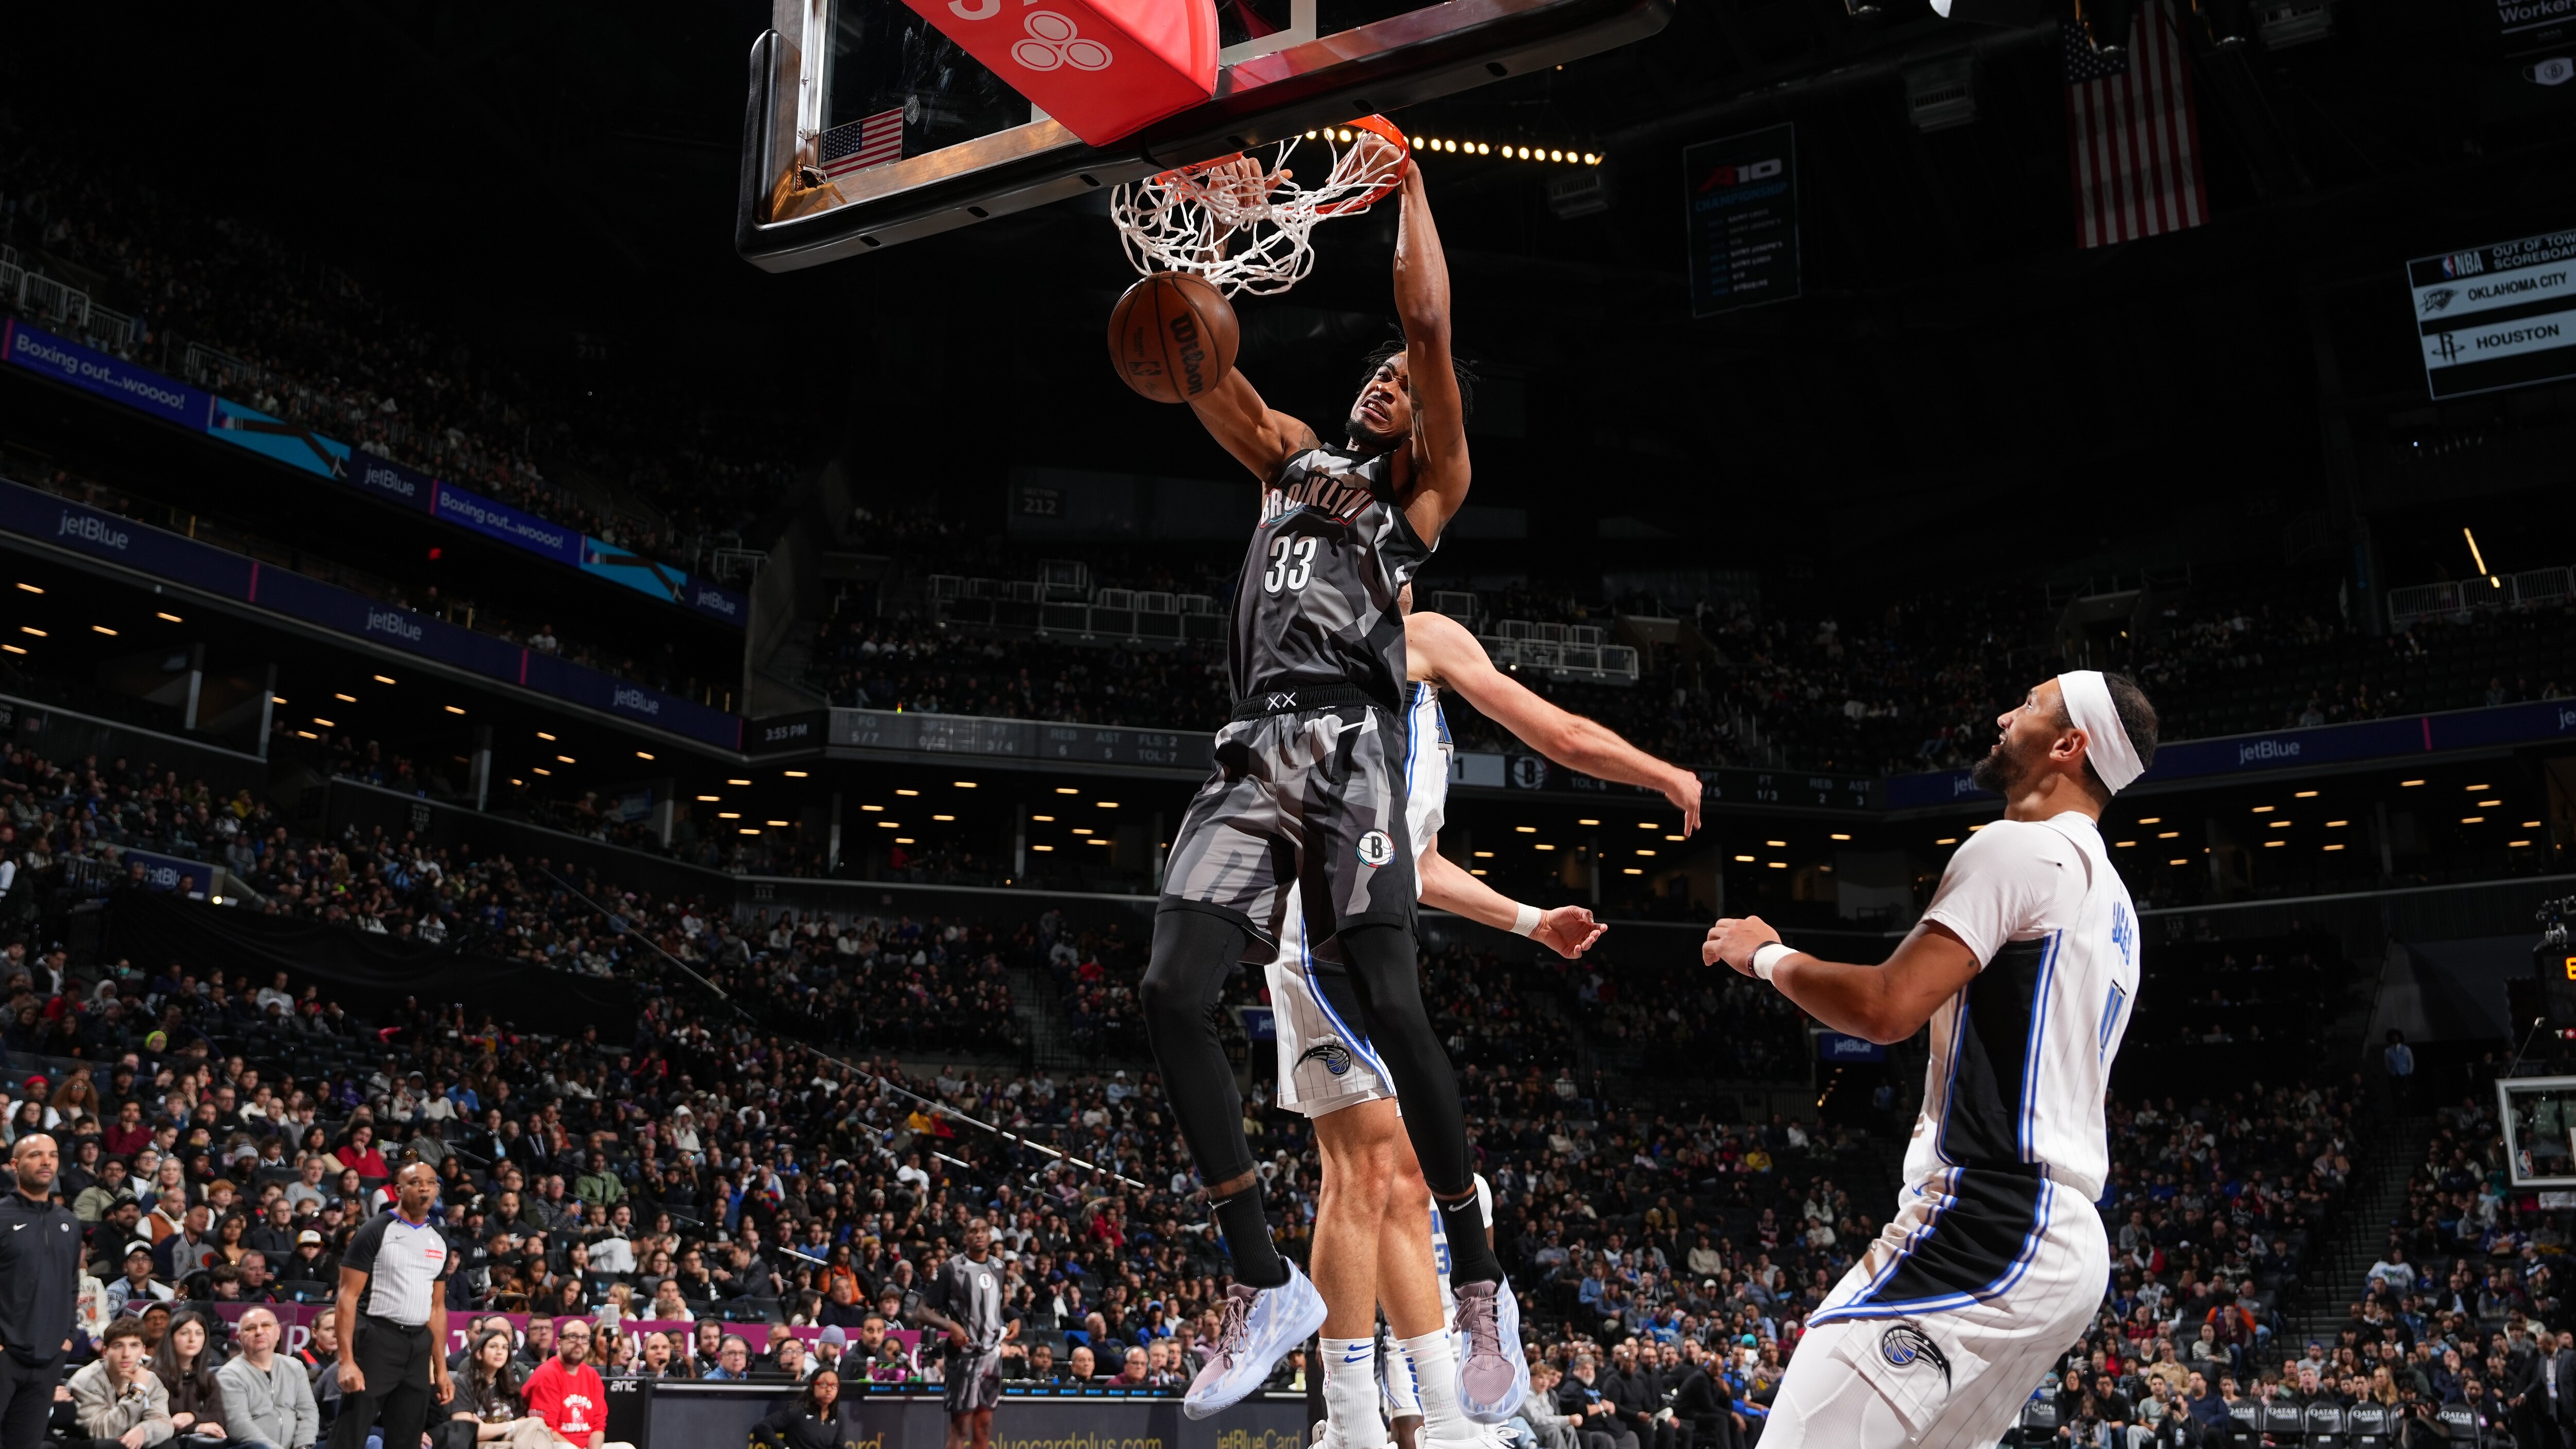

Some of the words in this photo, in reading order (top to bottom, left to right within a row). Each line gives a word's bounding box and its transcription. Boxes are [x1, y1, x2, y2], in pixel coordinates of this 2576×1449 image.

[2499, 0, 2576, 23] Worker
[2493, 243, 2520, 258] OUT
[2524, 239, 2543, 252] OF
[2547, 232, 2576, 247] TOW
[2494, 244, 2576, 270] SCOREBOAR
[2454, 251, 2484, 277] NBA
[2468, 278, 2537, 301] OKLAHOMA
[2540, 272, 2566, 288] CITY
[2477, 324, 2560, 349] HOUSTON
[16, 333, 78, 375] Boxing
[364, 463, 415, 497] jetBlue
[440, 491, 486, 522] Boxing
[1024, 498, 1056, 516] 212
[58, 510, 129, 550] jetBlue
[1264, 536, 1319, 594] 33
[697, 587, 736, 615] jetBlue
[365, 608, 422, 642] jetBlue
[613, 685, 659, 715] jetBlue
[789, 723, 807, 737] PM
[1050, 728, 1077, 742] REB
[1096, 732, 1121, 744] AST
[1170, 752, 1178, 763] 7
[2239, 740, 2300, 766] jetBlue
[1849, 781, 1871, 792] AST
[1371, 836, 1383, 859] B
[1834, 1038, 1872, 1055] jetBlue
[610, 1380, 637, 1392] anc
[2268, 1407, 2297, 1417] QATAR
[2310, 1408, 2340, 1418] QATAR
[2353, 1409, 2382, 1419] QATAR
[2441, 1411, 2472, 1421] QATAR
